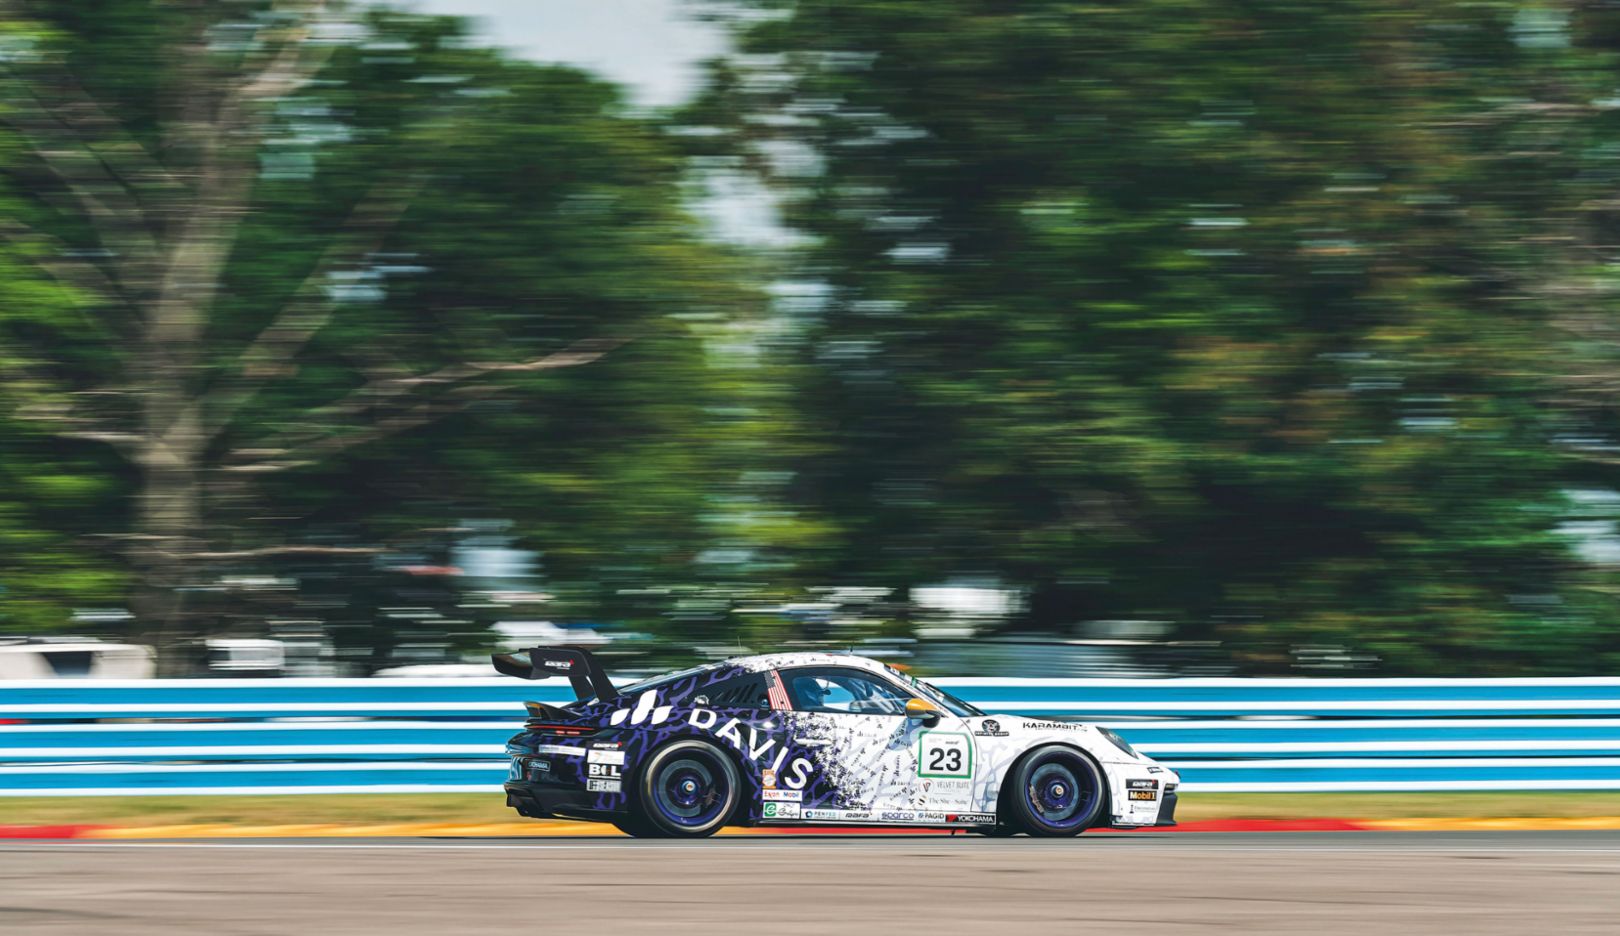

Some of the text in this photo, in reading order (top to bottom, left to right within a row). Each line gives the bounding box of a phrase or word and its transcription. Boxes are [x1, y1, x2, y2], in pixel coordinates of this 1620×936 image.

[688, 708, 814, 789] DAVIS
[929, 747, 962, 772] 23
[924, 812, 945, 820] PAGID
[958, 815, 994, 823] YOKOHAMA
